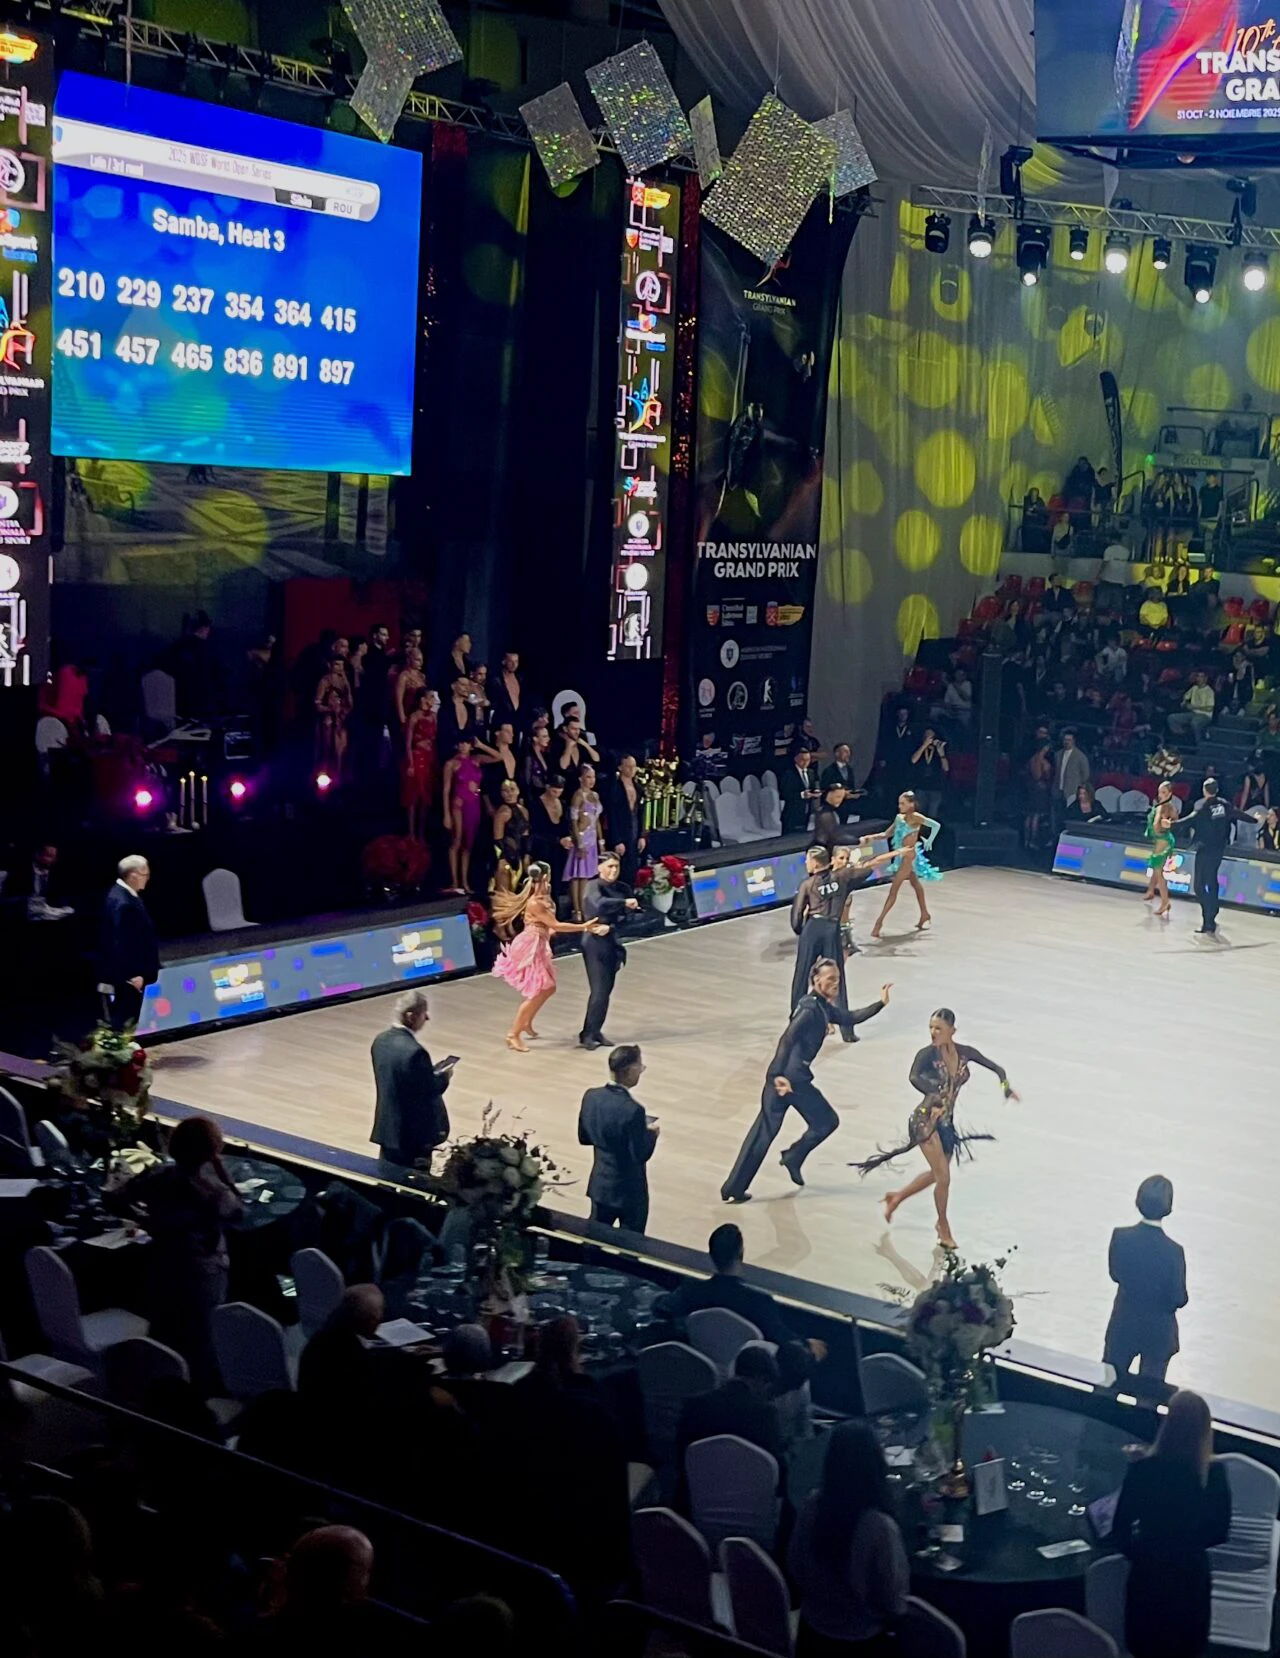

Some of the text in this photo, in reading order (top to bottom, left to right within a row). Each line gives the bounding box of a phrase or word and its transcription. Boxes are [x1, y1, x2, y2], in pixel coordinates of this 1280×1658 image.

[1186, 109, 1203, 119] OCT
[1209, 109, 1215, 118] 2
[333, 202, 353, 214] ROU
[152, 208, 285, 252] Samba, Heat 3
[58, 267, 357, 333] 210 229 237 354 364 415
[743, 289, 796, 307] TRANSYLVANIAN
[57, 329, 355, 385] 451 457 465 836 891 897
[697, 542, 817, 559] TRANSYLVANIAN
[714, 562, 800, 578] GRAND PRIX
[817, 881, 839, 895] 719
